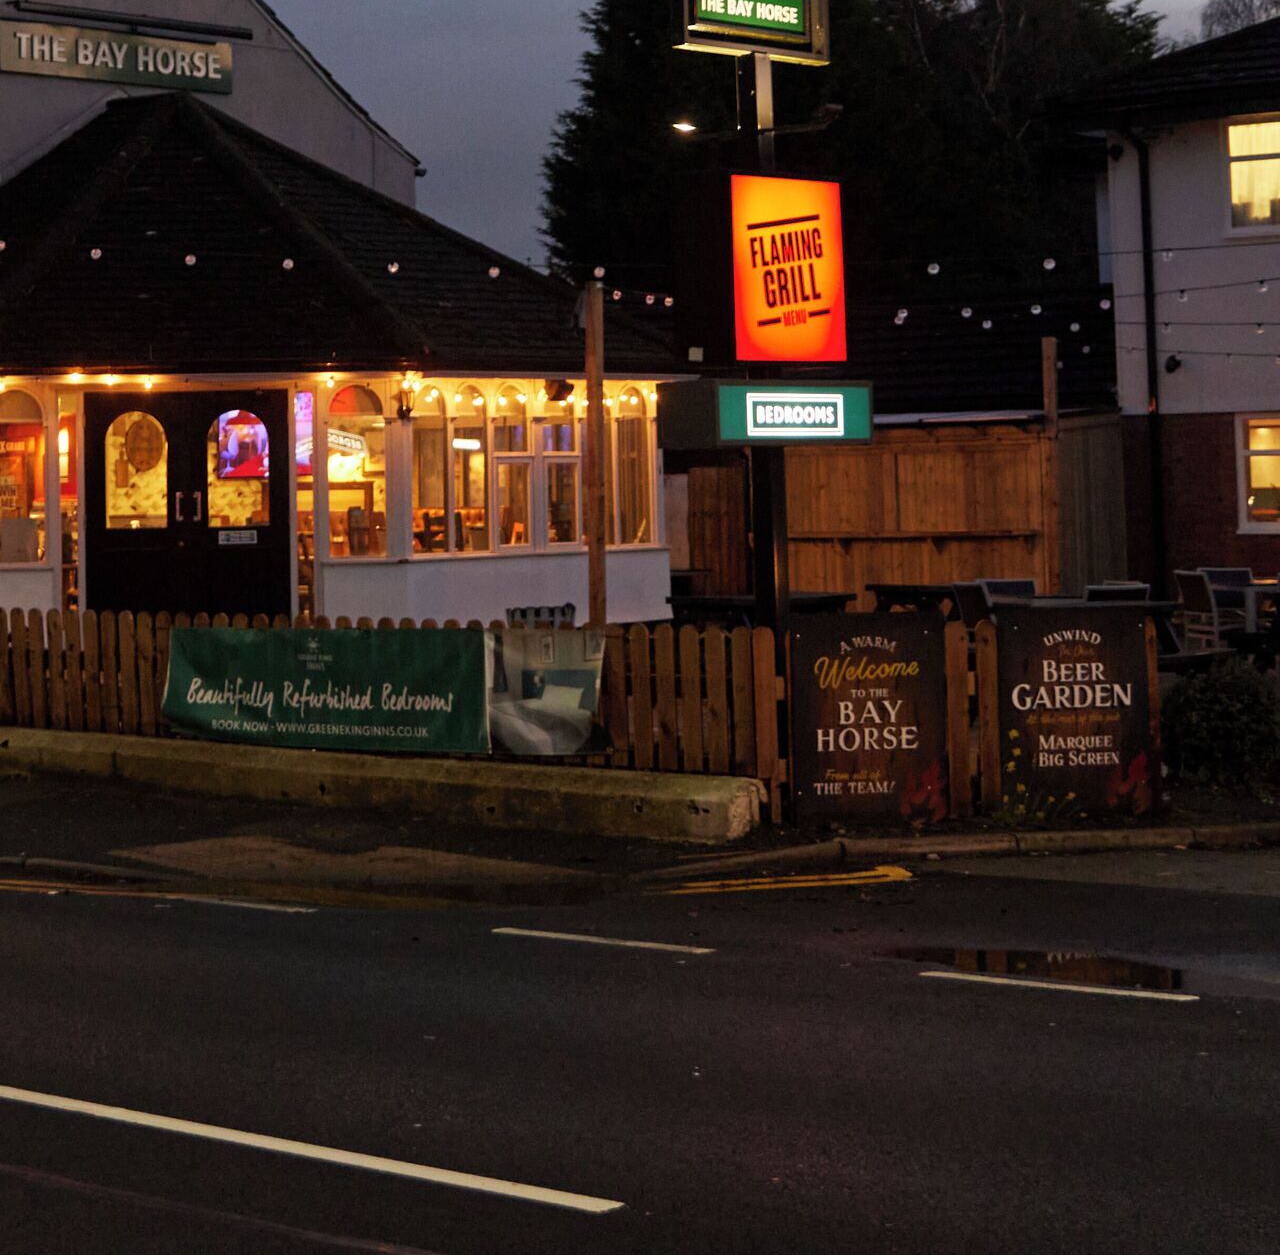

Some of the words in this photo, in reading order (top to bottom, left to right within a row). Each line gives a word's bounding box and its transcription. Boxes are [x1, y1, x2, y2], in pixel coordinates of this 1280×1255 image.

[756, 3, 798, 23] HORSE
[14, 31, 67, 63] THE
[77, 38, 128, 69] BAY
[137, 47, 222, 79] HORSE
[750, 227, 824, 269] FLAMING
[763, 263, 822, 309] GRILL
[783, 309, 807, 327] MENU
[756, 404, 836, 425] BEDROOMS
[840, 641, 852, 655] A
[852, 635, 897, 653] WARM
[1043, 629, 1102, 647] UNWIND
[814, 656, 920, 690] Welcome
[1042, 659, 1106, 683] BEER
[186, 677, 274, 719] Beautifully
[283, 678, 375, 719] Refurbished
[382, 682, 454, 713] Bedrooms
[850, 689, 866, 698] TO
[868, 688, 889, 697] THE
[1011, 683, 1132, 711] GARDEN
[838, 699, 903, 725] BAY
[212, 719, 240, 731] BOOK
[243, 721, 269, 732] NOW
[276, 721, 429, 737] WWW.GREENEKINGINNS.CO.UK
[816, 726, 920, 752] HORSE
[1039, 734, 1113, 751] MARQUEE
[1039, 751, 1064, 767] BIG
[1068, 750, 1120, 766] SCREEN
[814, 781, 842, 796] THE
[848, 781, 896, 795] TEAM!
